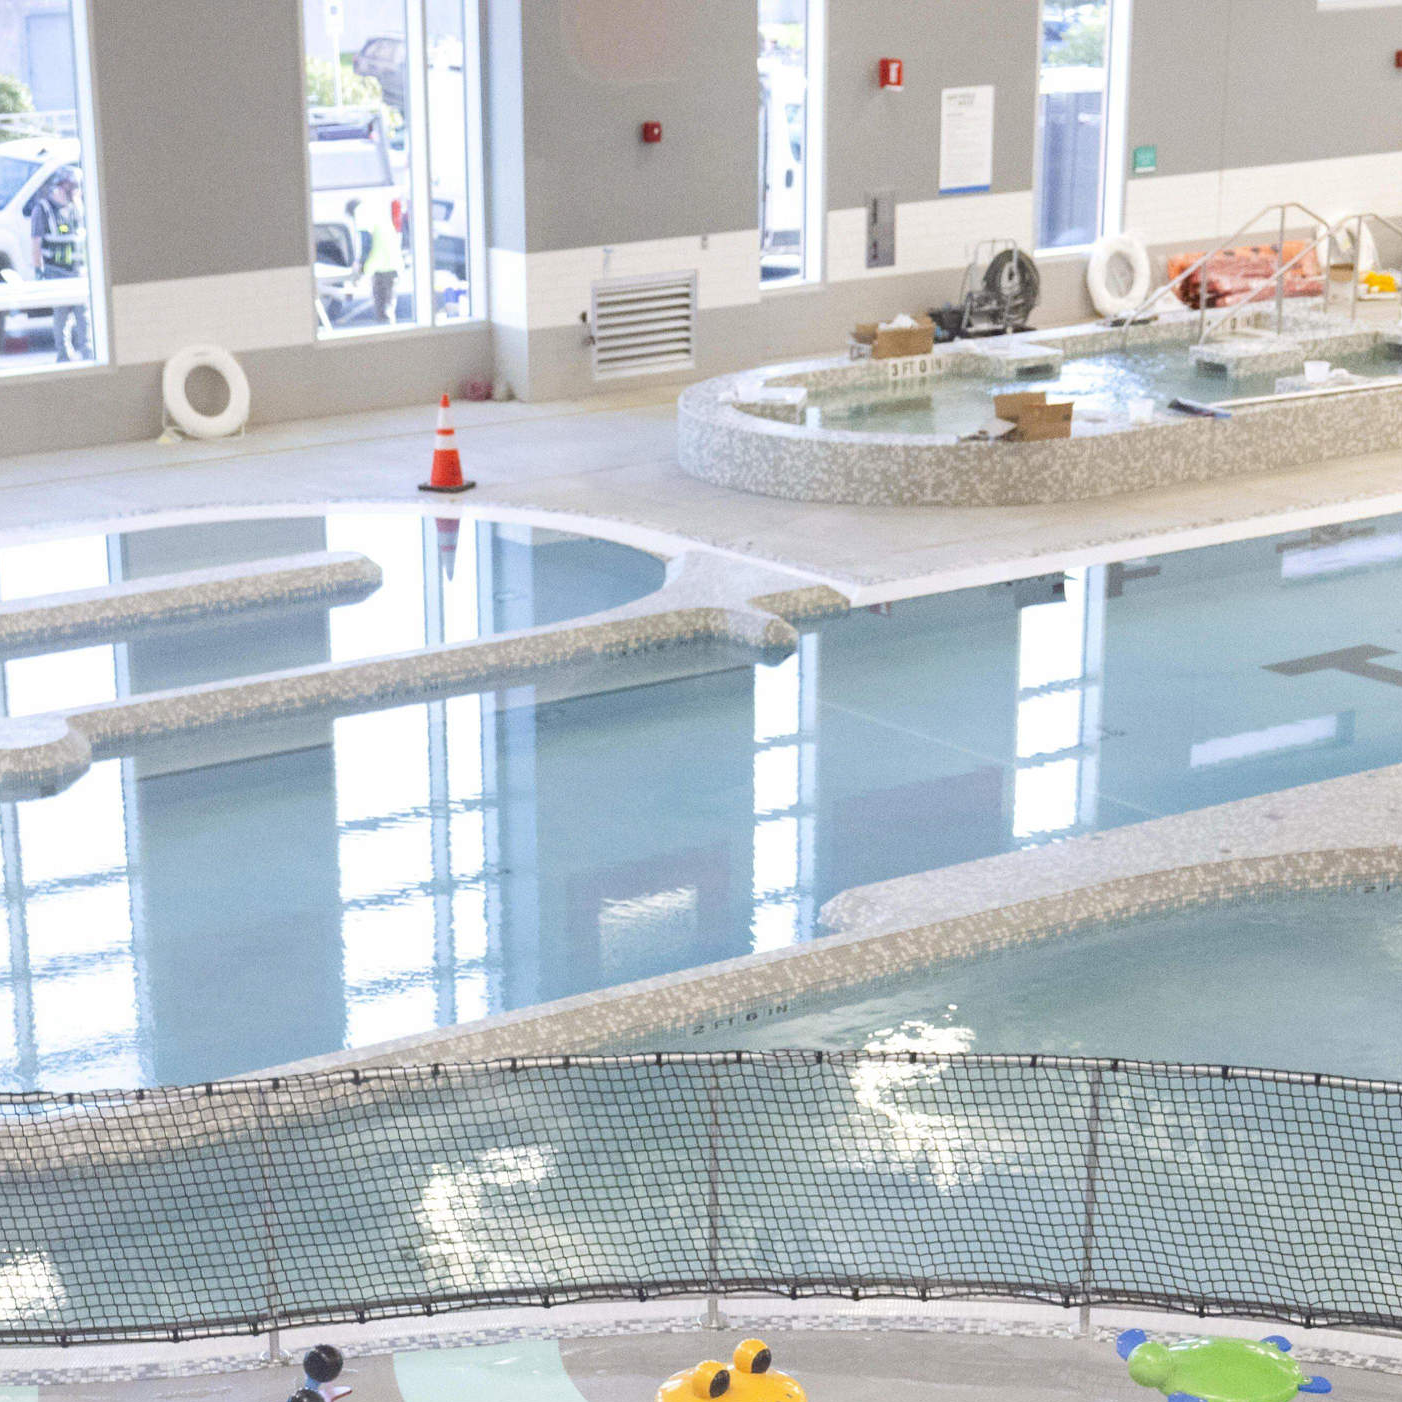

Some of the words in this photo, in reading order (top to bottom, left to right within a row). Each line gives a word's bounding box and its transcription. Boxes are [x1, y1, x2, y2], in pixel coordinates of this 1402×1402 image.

[891, 363, 898, 377] 3
[902, 360, 915, 377] FT
[919, 359, 927, 373] 0
[692, 1024, 705, 1036] 2
[768, 1004, 788, 1016] IN
